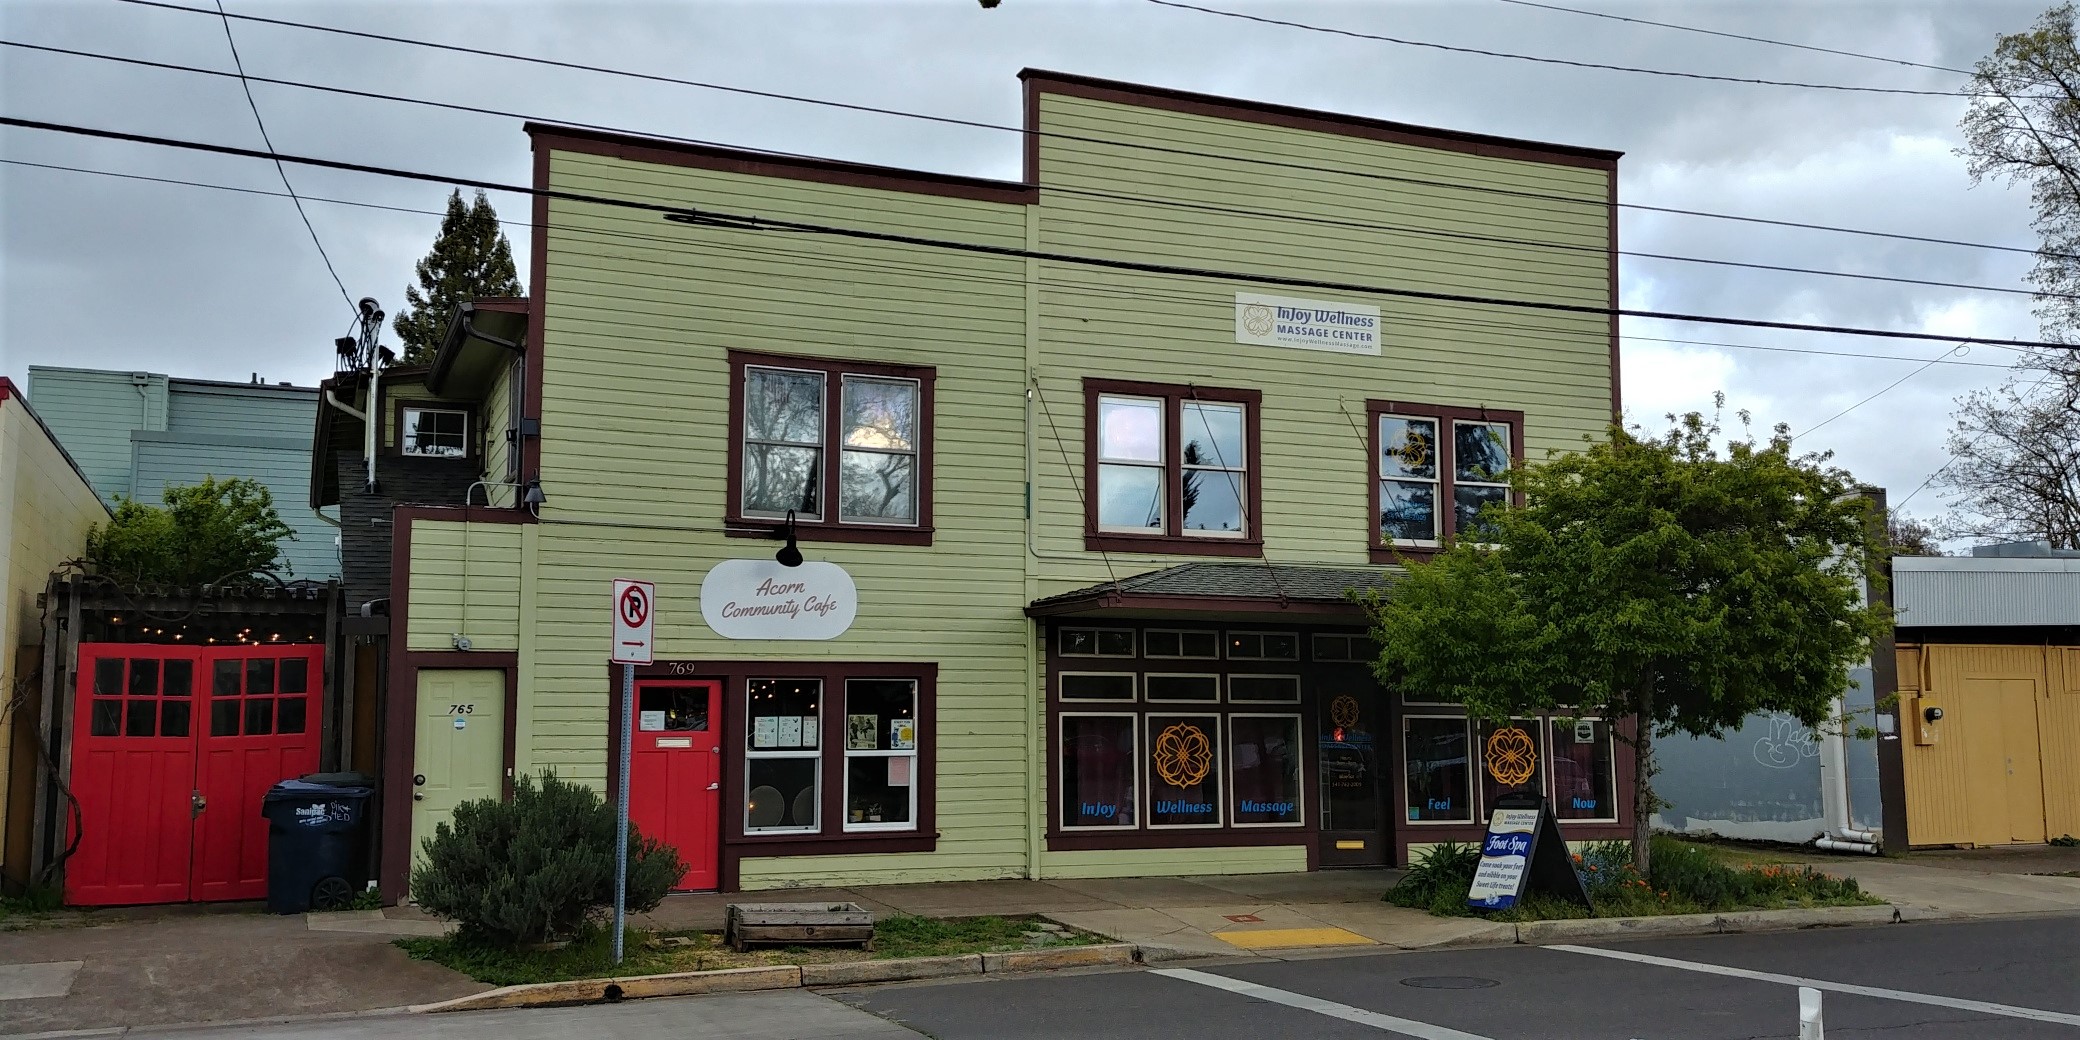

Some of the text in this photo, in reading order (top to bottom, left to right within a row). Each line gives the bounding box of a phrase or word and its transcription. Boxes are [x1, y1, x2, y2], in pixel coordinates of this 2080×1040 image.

[1277, 306, 1374, 328] InJoy Wellness
[1277, 324, 1373, 342] MASSAGE CENTER
[755, 577, 805, 597] Acorn
[721, 594, 838, 619] Community Cafe
[669, 662, 695, 675] 769
[448, 704, 474, 715] 765
[1081, 800, 1294, 818] InJoy Wellness Massage
[1428, 797, 1597, 810] Feel Now
[1486, 835, 1528, 854] Foot Spa
[1513, 862, 1523, 871] feet
[1489, 881, 1499, 889] Life
